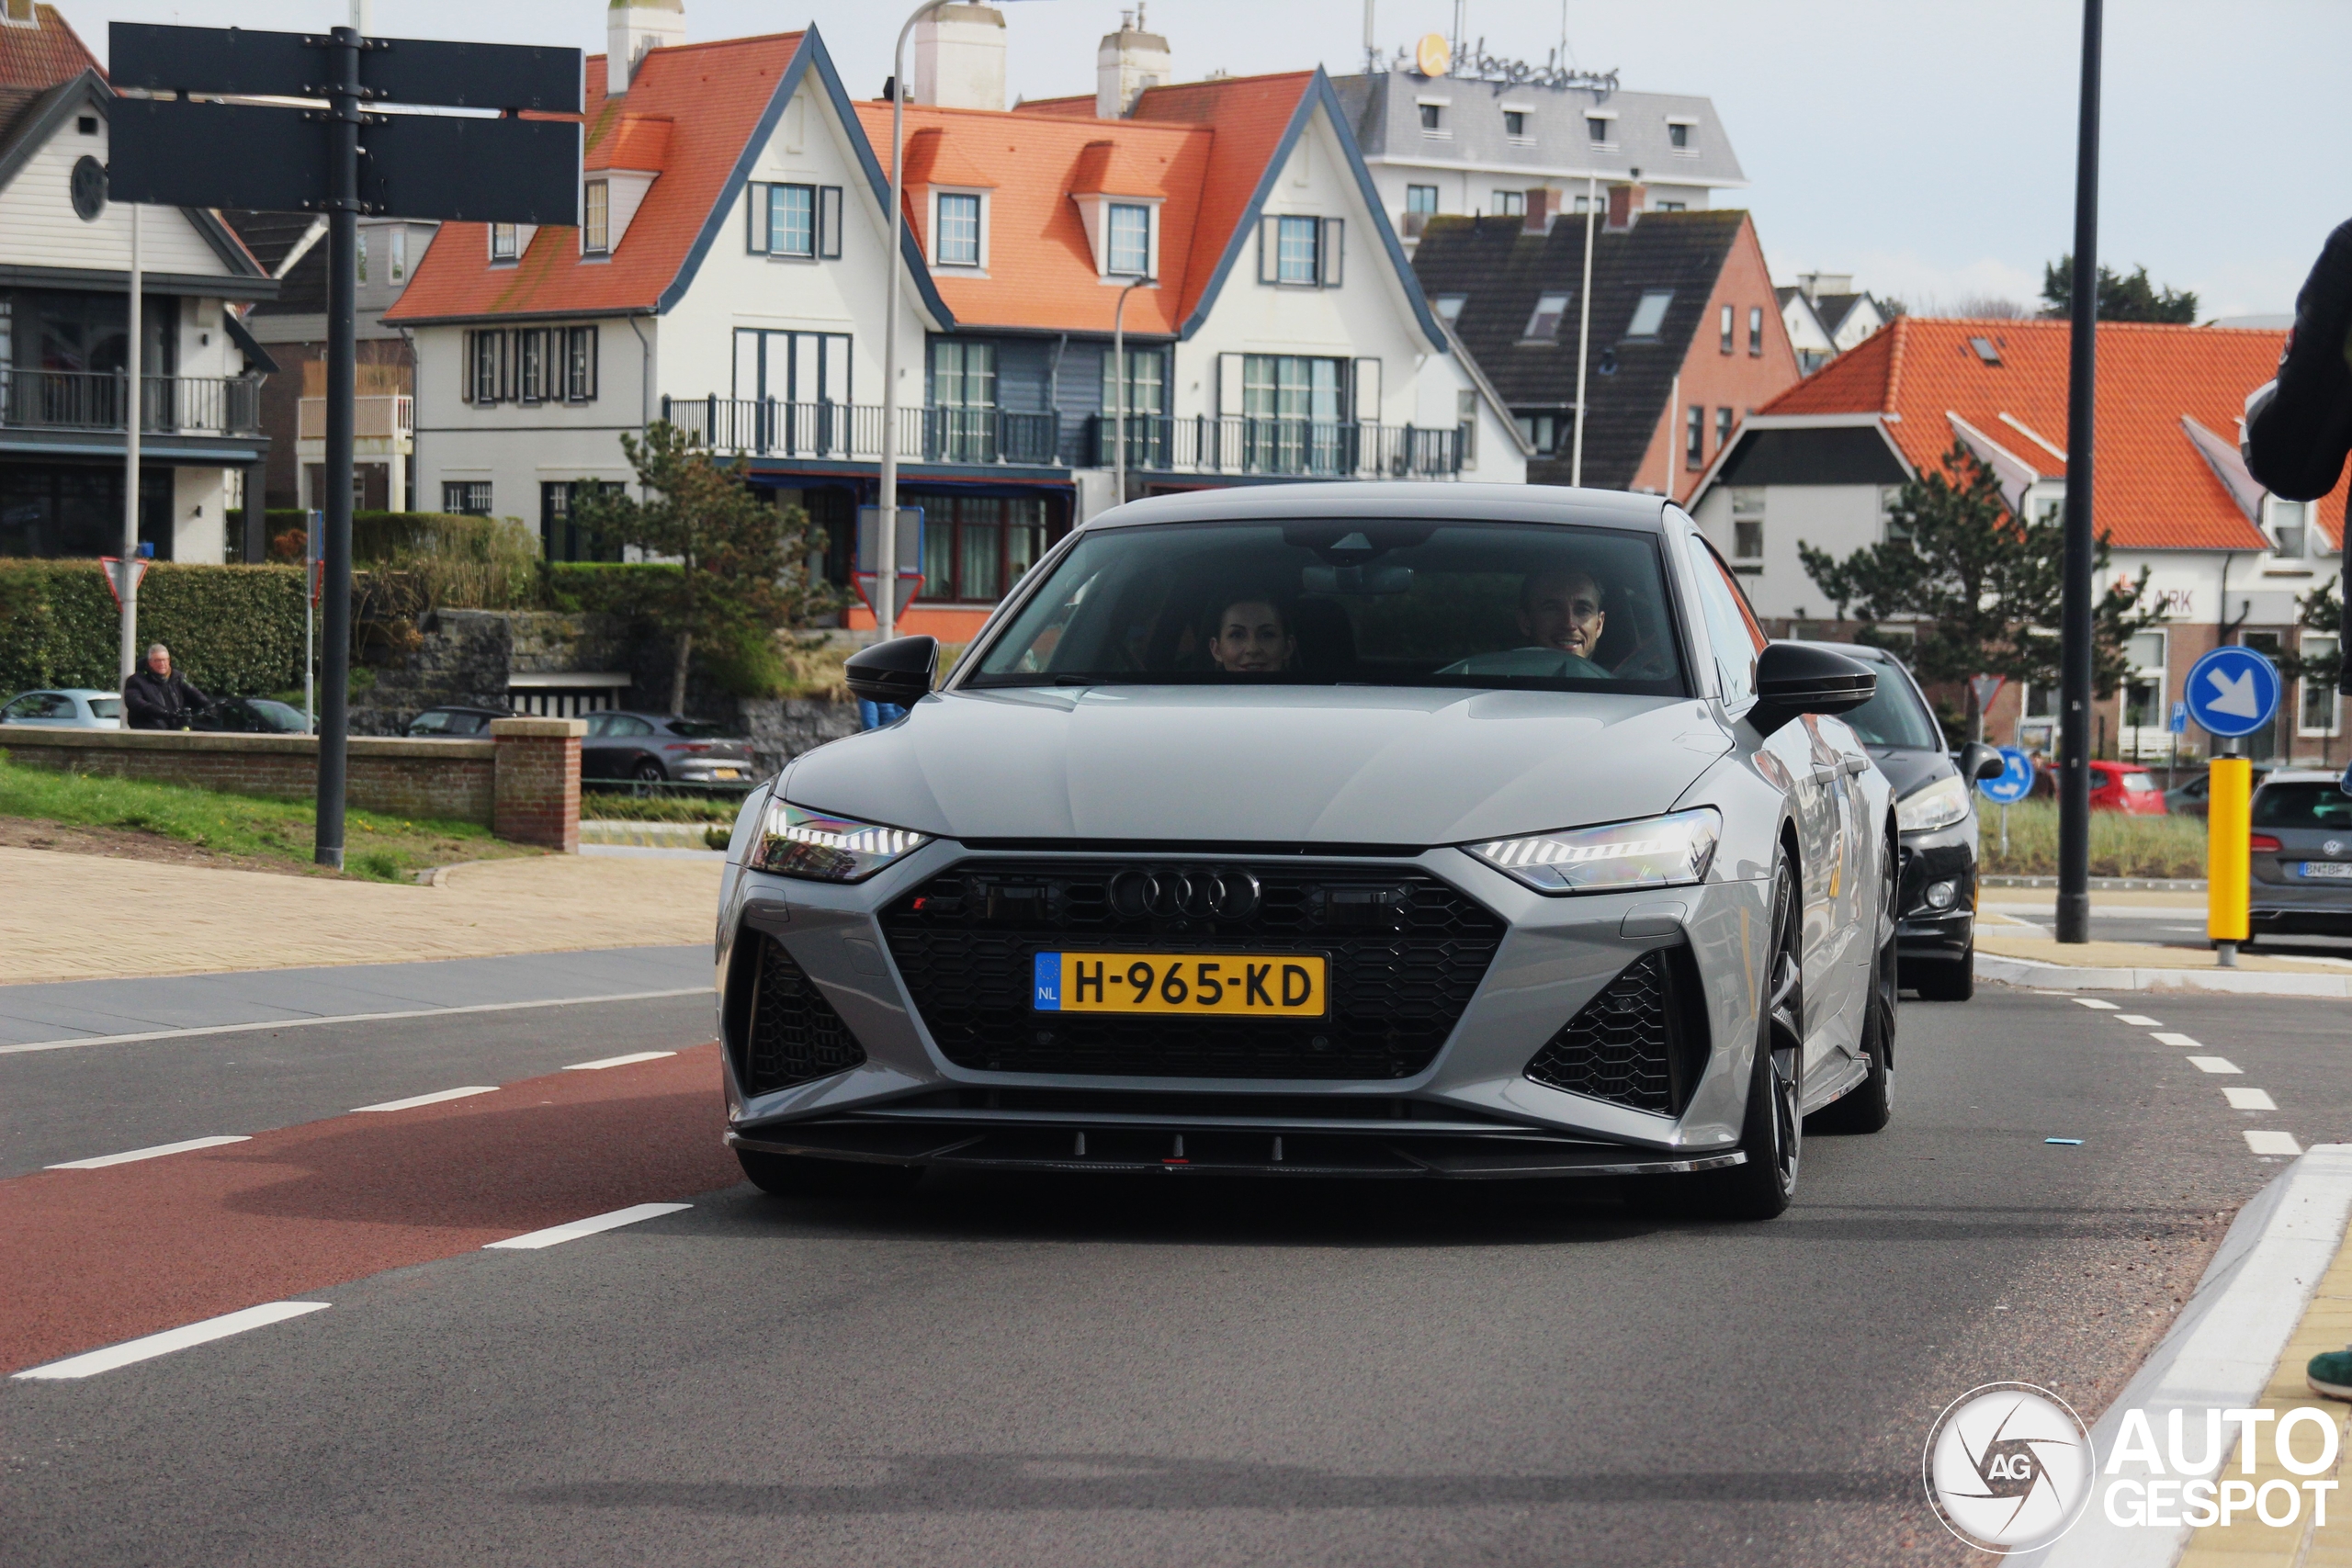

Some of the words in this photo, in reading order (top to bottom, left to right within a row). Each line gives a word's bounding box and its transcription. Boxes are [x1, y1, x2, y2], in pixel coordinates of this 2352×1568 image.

[2153, 589, 2193, 614] ARK
[1038, 987, 1057, 1001] NL
[1075, 961, 1312, 1007] H-965-KD
